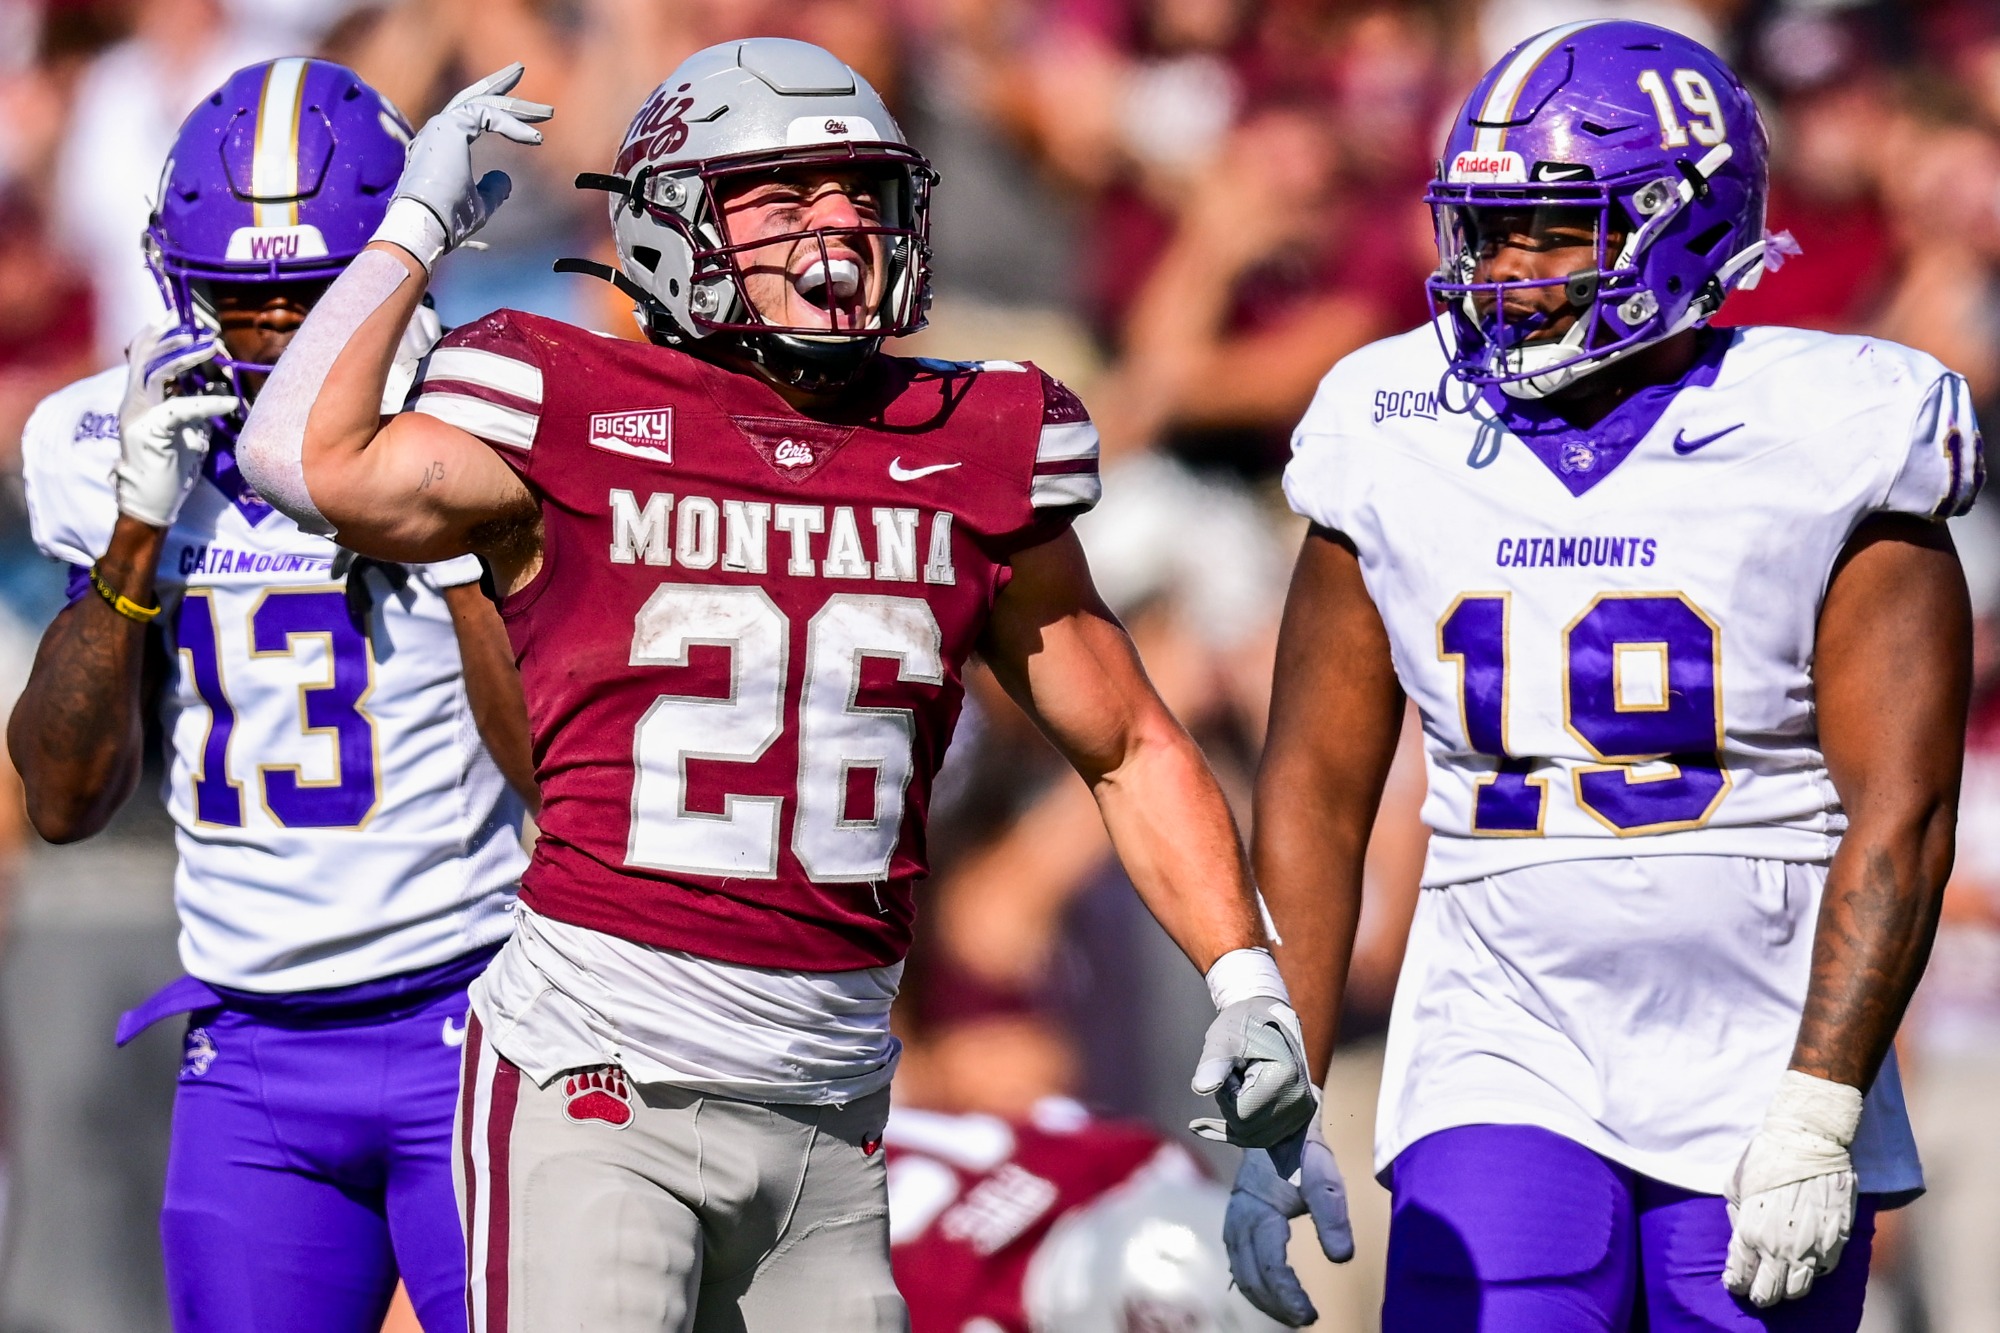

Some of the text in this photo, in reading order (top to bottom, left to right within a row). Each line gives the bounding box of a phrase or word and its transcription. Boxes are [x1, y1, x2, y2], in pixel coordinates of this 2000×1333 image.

[824, 119, 849, 134] Griz
[1637, 67, 1727, 151] 19
[1456, 157, 1511, 172] Riddell
[251, 234, 299, 259] WCU
[774, 439, 814, 465] Griz
[609, 488, 956, 585] MONTANA
[1496, 537, 1657, 568] CATAMOUNTS
[177, 585, 381, 831] 13
[623, 582, 945, 884] 26
[1435, 590, 1733, 838] 19
